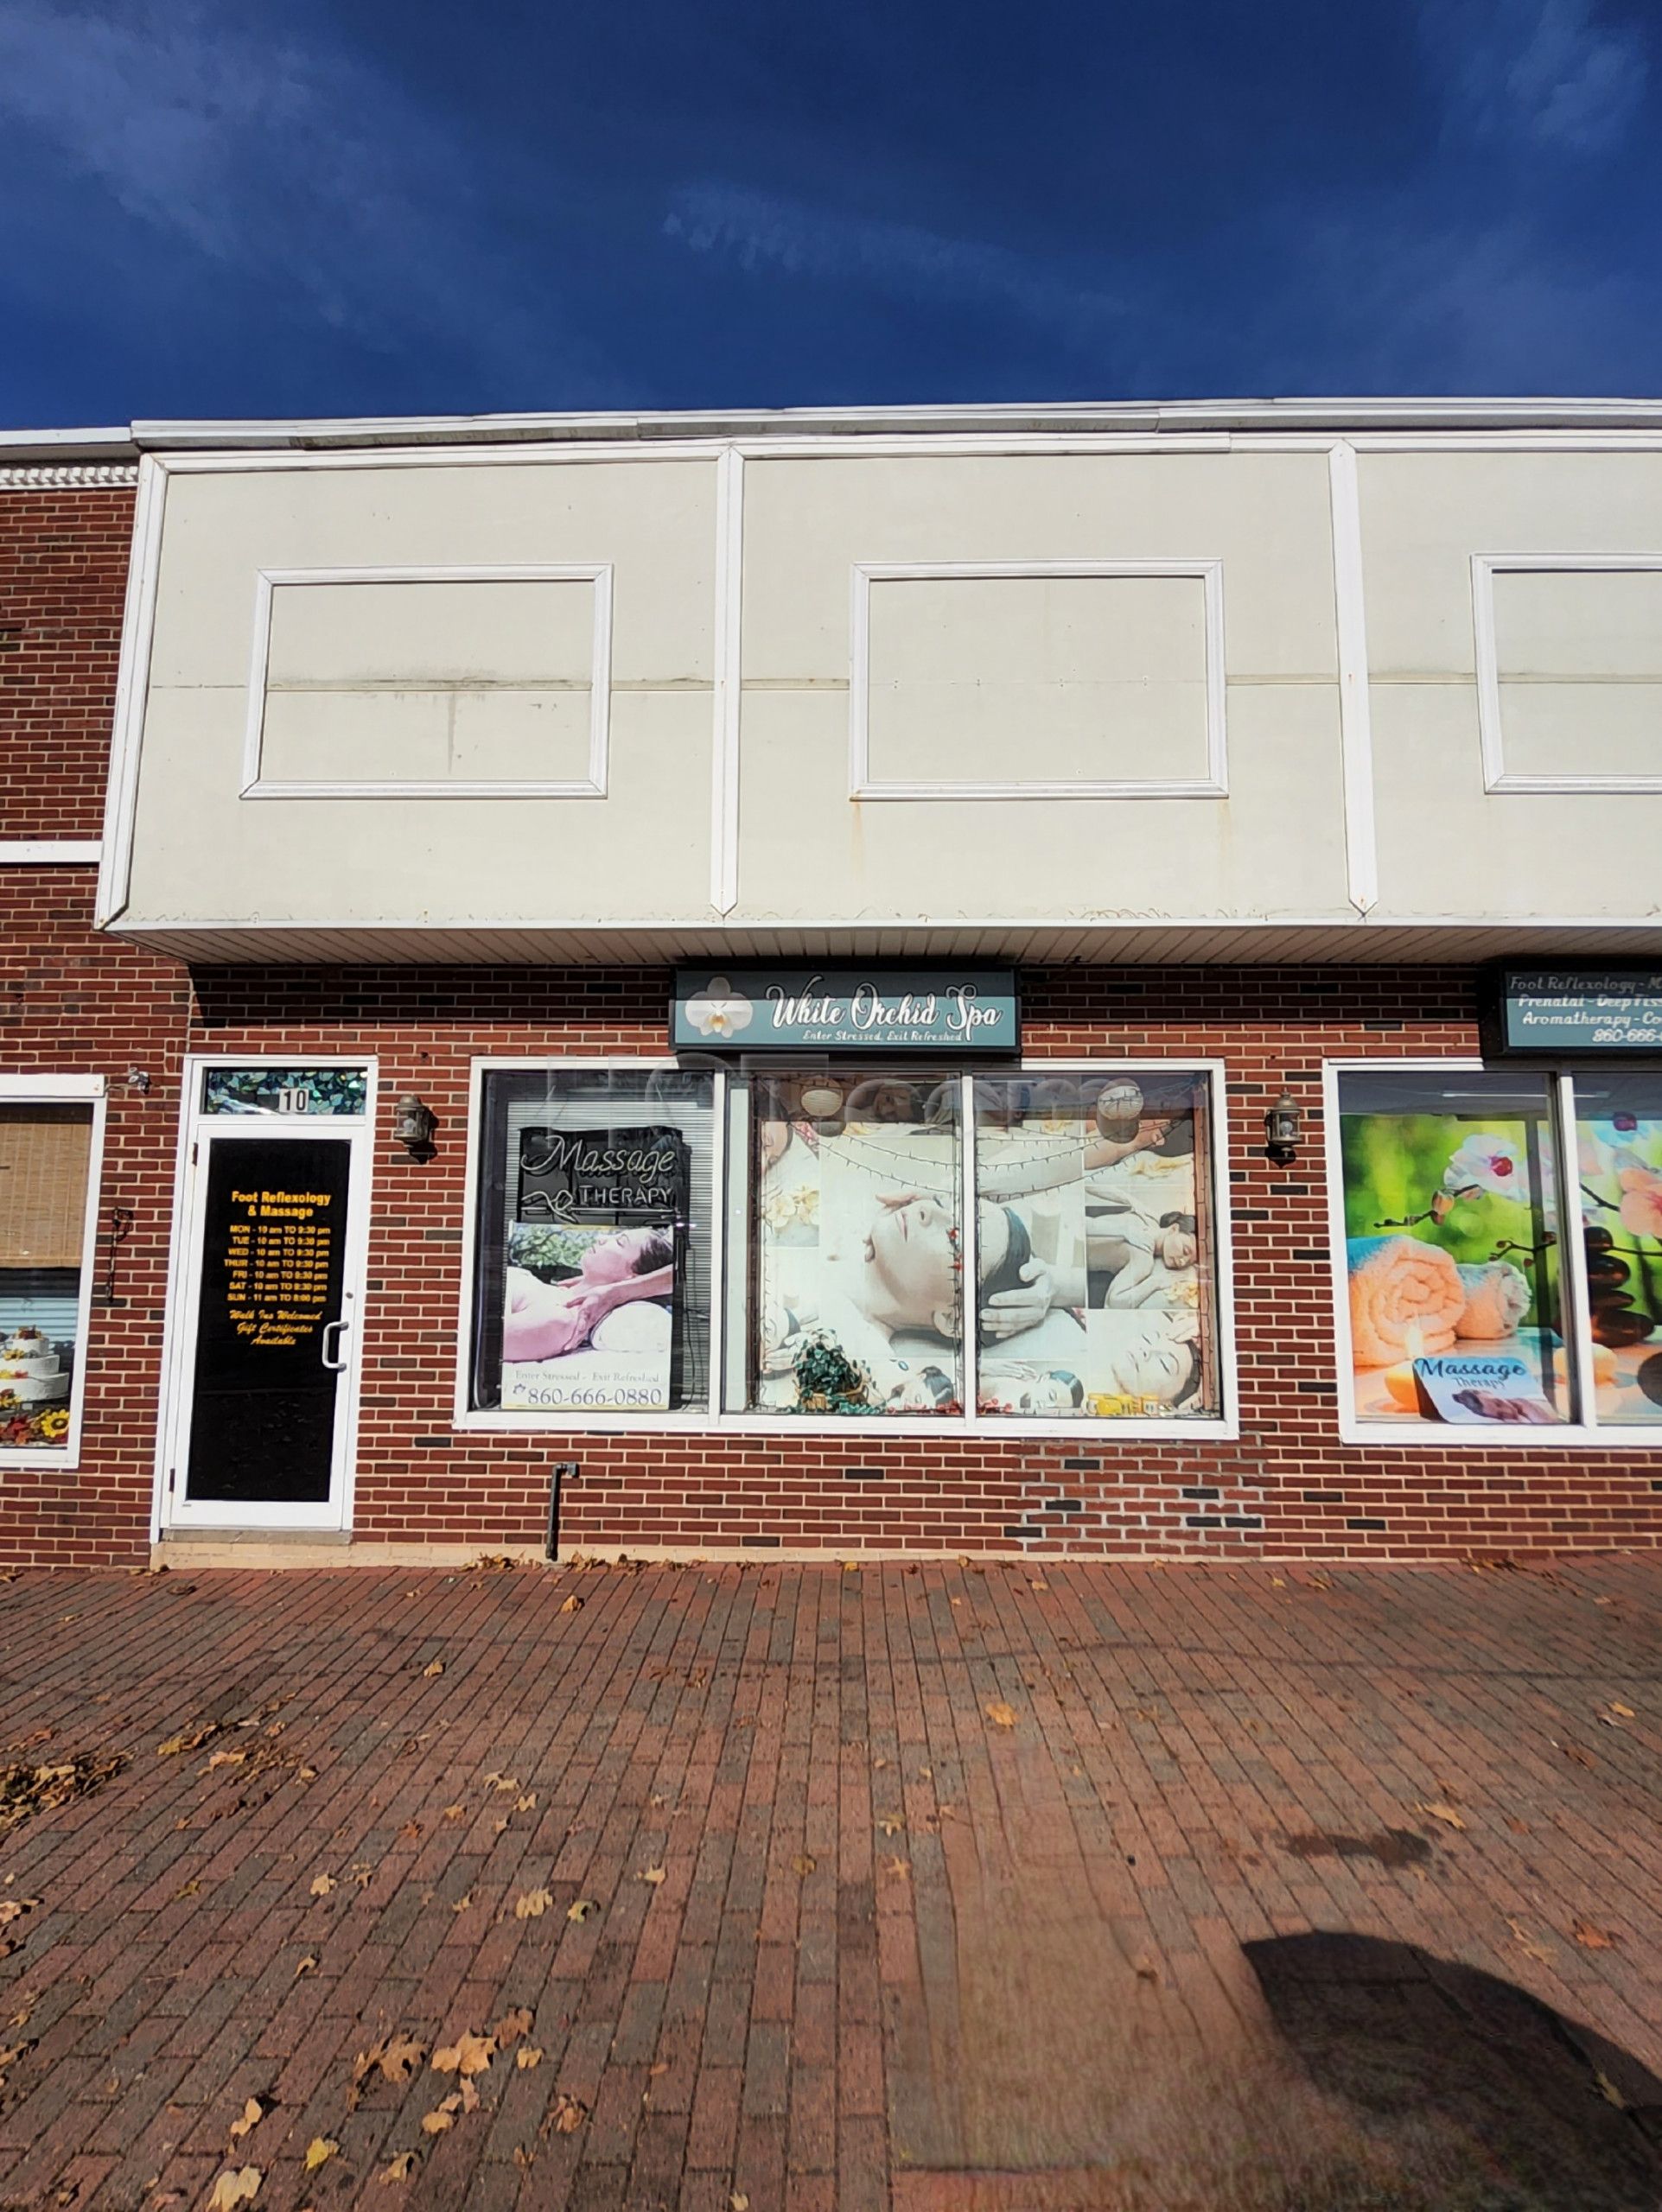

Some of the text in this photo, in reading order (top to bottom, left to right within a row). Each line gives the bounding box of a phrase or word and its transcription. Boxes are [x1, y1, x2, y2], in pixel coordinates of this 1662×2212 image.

[1511, 977, 1544, 989] Foot
[1547, 976, 1636, 994] Reflexology
[766, 975, 1003, 1041] White Orchid Spa
[1519, 994, 1584, 1007] Prenatal
[1596, 994, 1632, 1011] Deep
[1523, 1011, 1631, 1028] Aromatherapy
[803, 1030, 831, 1040] Enter
[887, 1031, 907, 1041] Exit
[911, 1030, 962, 1041] Refreshed
[284, 1090, 306, 1110] 10
[520, 1135, 675, 1183] Massage
[232, 1191, 331, 1206] Foot Reflexology
[578, 1185, 672, 1204] THERAPY
[248, 1205, 314, 1220] & Massage
[230, 1225, 251, 1234] MON
[258, 1225, 268, 1234] 10
[283, 1225, 296, 1234] TO
[317, 1227, 331, 1236] pm
[232, 1236, 250, 1245] TUE
[258, 1236, 267, 1245] 10
[283, 1236, 296, 1245] TO
[228, 1248, 249, 1256] WED
[257, 1248, 266, 1256] 10
[224, 1259, 248, 1268] THUR
[255, 1259, 265, 1268] 10
[282, 1259, 294, 1268] TO
[315, 1262, 328, 1270] pm
[232, 1270, 248, 1279] FRI
[281, 1271, 293, 1280] TO
[314, 1273, 328, 1281] pm
[229, 1281, 246, 1290] SAT
[280, 1282, 293, 1291] TO
[313, 1284, 328, 1293] pm
[312, 1295, 327, 1304] pm
[277, 1309, 323, 1320] Welcomed
[237, 1321, 313, 1335] Gift Certificates
[250, 1334, 296, 1345] Available
[515, 1370, 539, 1380] Enter
[543, 1370, 580, 1381] Stressed
[592, 1372, 610, 1382] Exit
[613, 1372, 659, 1382] Refreshed
[1414, 1357, 1526, 1381] Massage
[1451, 1376, 1506, 1390] Therapy
[528, 1388, 662, 1406] 860-666-0880
